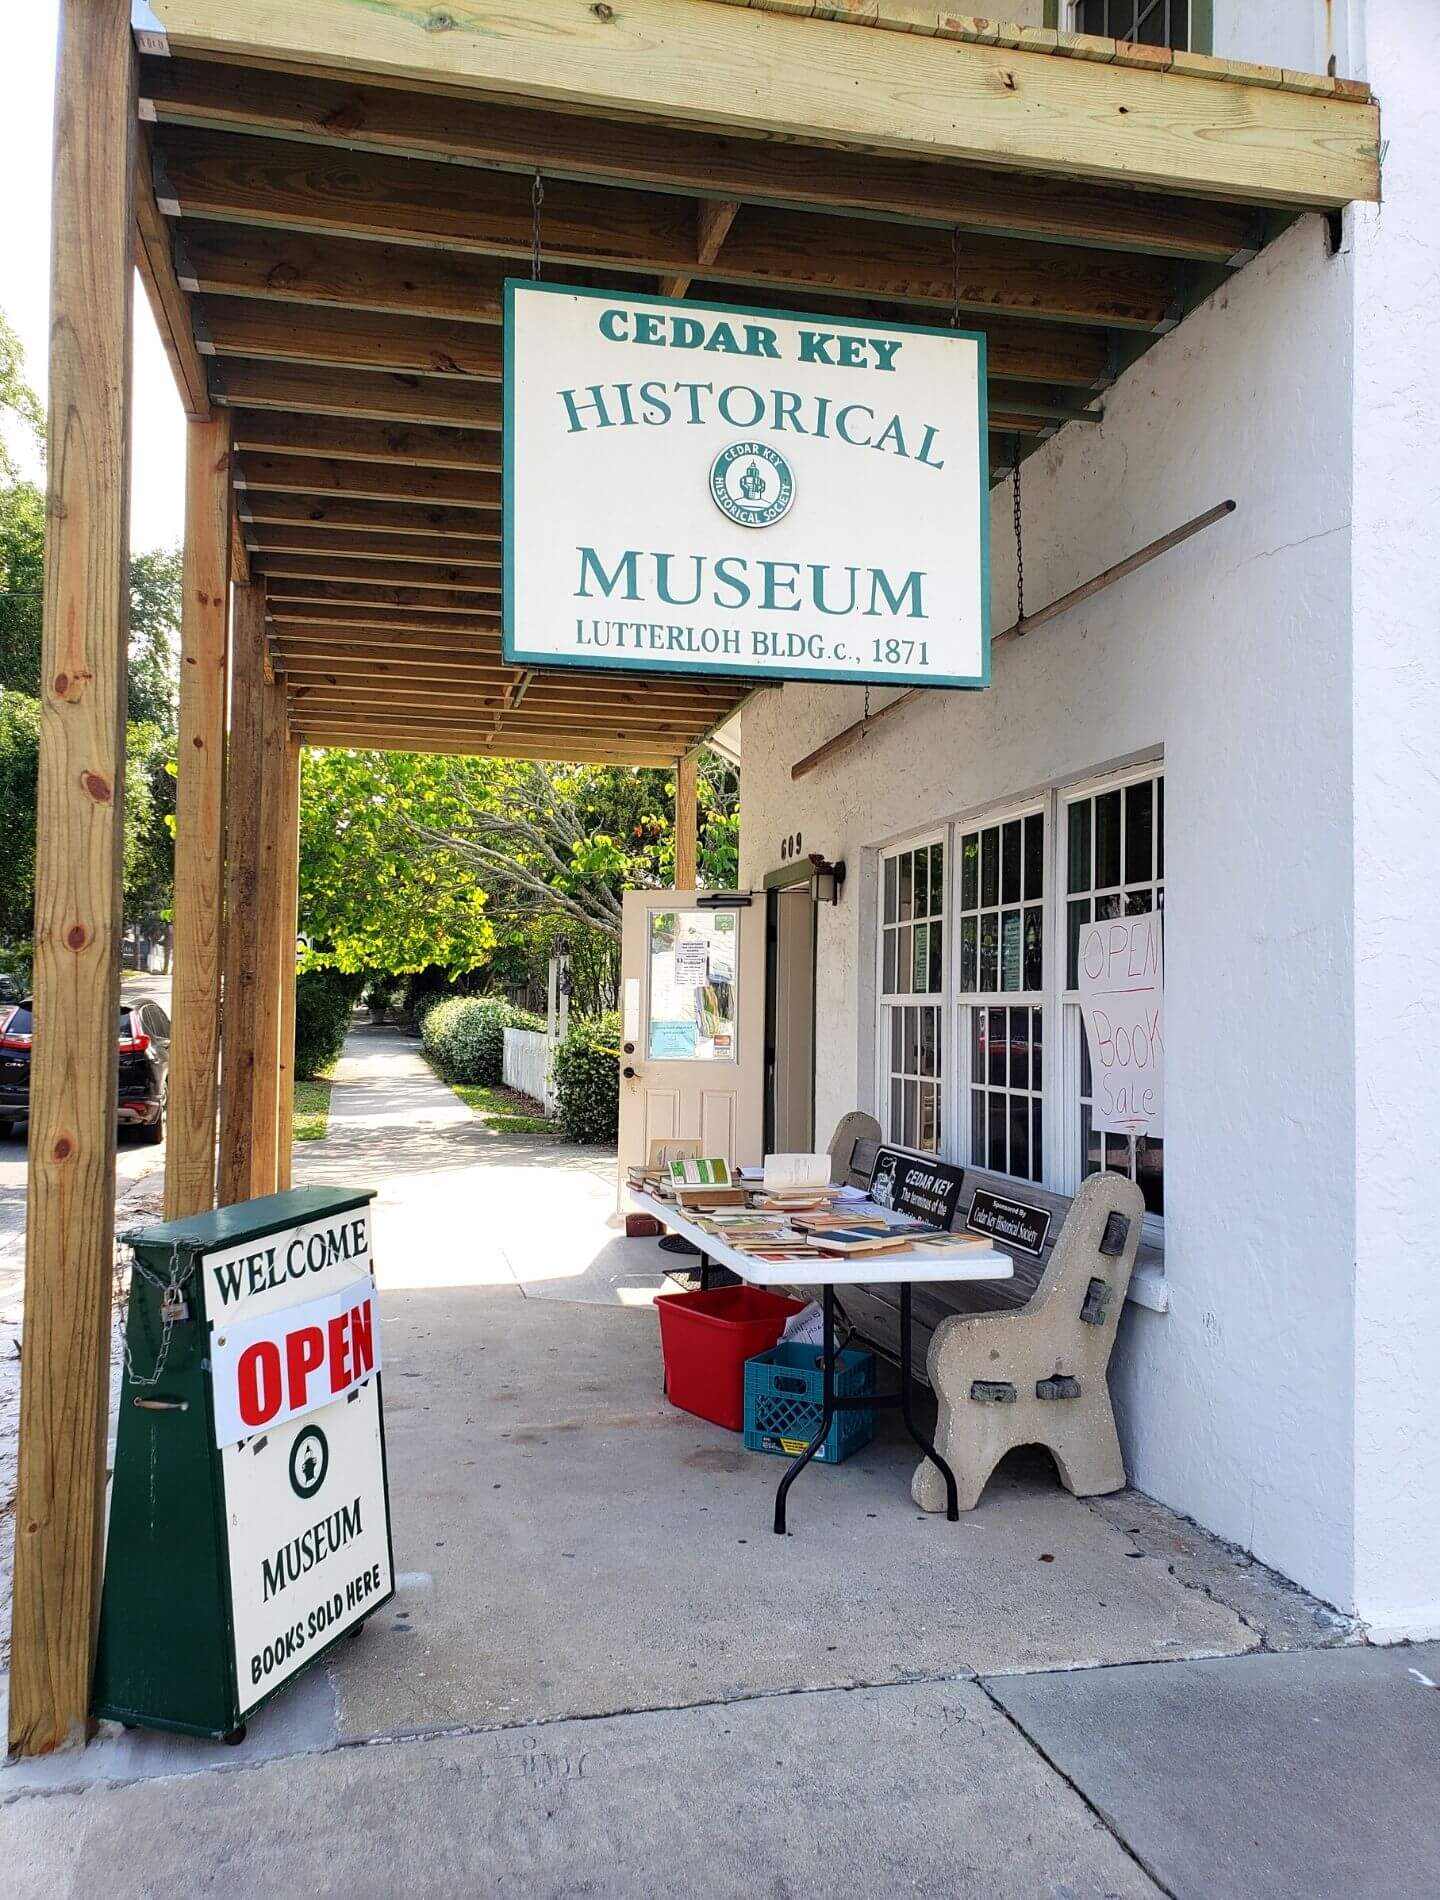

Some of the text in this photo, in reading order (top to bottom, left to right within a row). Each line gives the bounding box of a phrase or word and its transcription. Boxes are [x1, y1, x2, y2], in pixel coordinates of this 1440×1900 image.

[599, 309, 902, 372] CEDAR KEY
[556, 380, 945, 470] HISTORICAL
[724, 444, 782, 467] CEDAR KEY
[715, 477, 791, 523] HISTORICAL SOCIETY
[573, 546, 929, 619] MUSEUM
[576, 619, 741, 654] LUTTERLOH
[872, 638, 930, 665] 1871
[781, 831, 802, 860] 609
[1083, 920, 1159, 979] OPEN
[901, 1186, 911, 1202] The
[931, 1199, 940, 1212] of
[937, 1200, 948, 1216] the
[905, 1169, 954, 1197] CEDAR KEY
[973, 1207, 1039, 1247] Cedar Key Historical Society
[213, 1217, 368, 1305] WELCOME
[237, 1299, 374, 1427] OPEN
[261, 1496, 363, 1603] MUSEUM
[251, 1563, 381, 1684] BOOKS SOLD HERE
